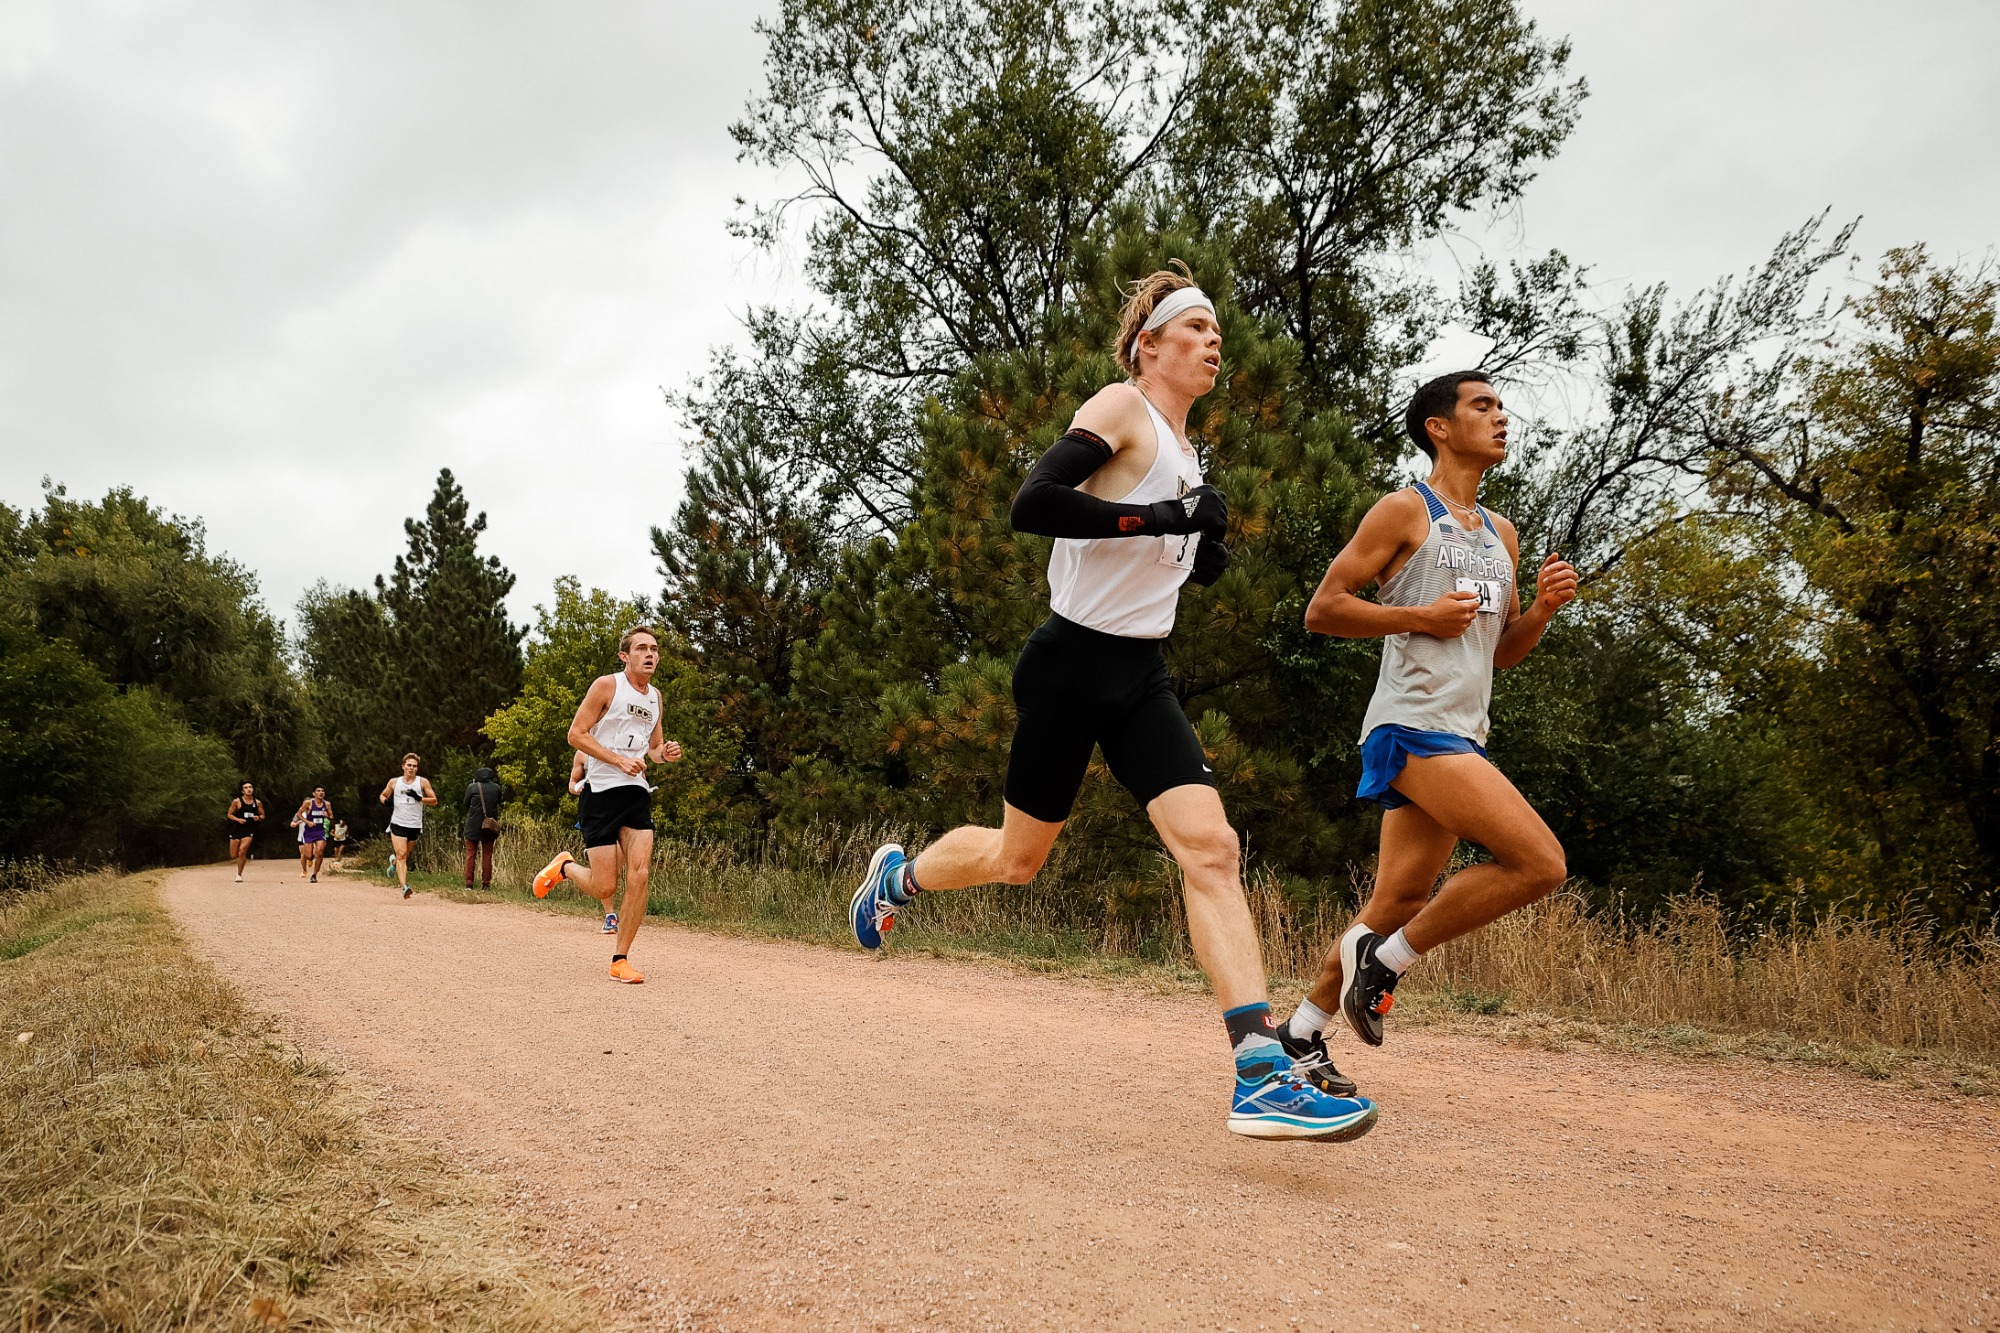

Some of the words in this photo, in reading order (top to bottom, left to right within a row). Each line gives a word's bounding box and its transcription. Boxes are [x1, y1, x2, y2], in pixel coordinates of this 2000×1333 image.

[1177, 534, 1189, 562] 3
[1435, 544, 1466, 570] AIR
[1467, 550, 1512, 581] FORCE
[1474, 581, 1491, 607] 34
[627, 703, 653, 721] UCCS
[627, 735, 634, 748] 7
